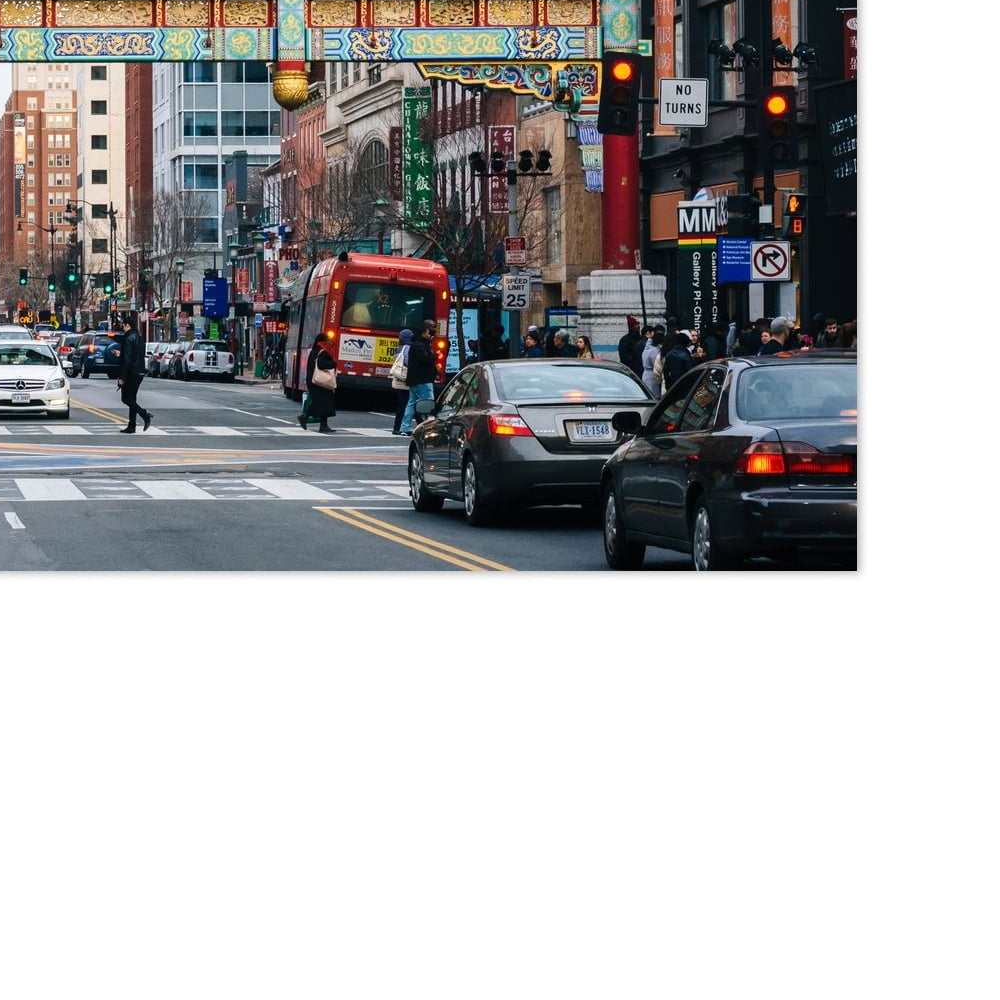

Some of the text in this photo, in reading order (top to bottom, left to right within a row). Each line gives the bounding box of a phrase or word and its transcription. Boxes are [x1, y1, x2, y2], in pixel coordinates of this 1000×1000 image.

[675, 84, 692, 96] NO
[665, 102, 702, 115] TURNS
[279, 248, 300, 260] PHO
[692, 251, 701, 288] Gallery
[506, 293, 527, 308] 25
